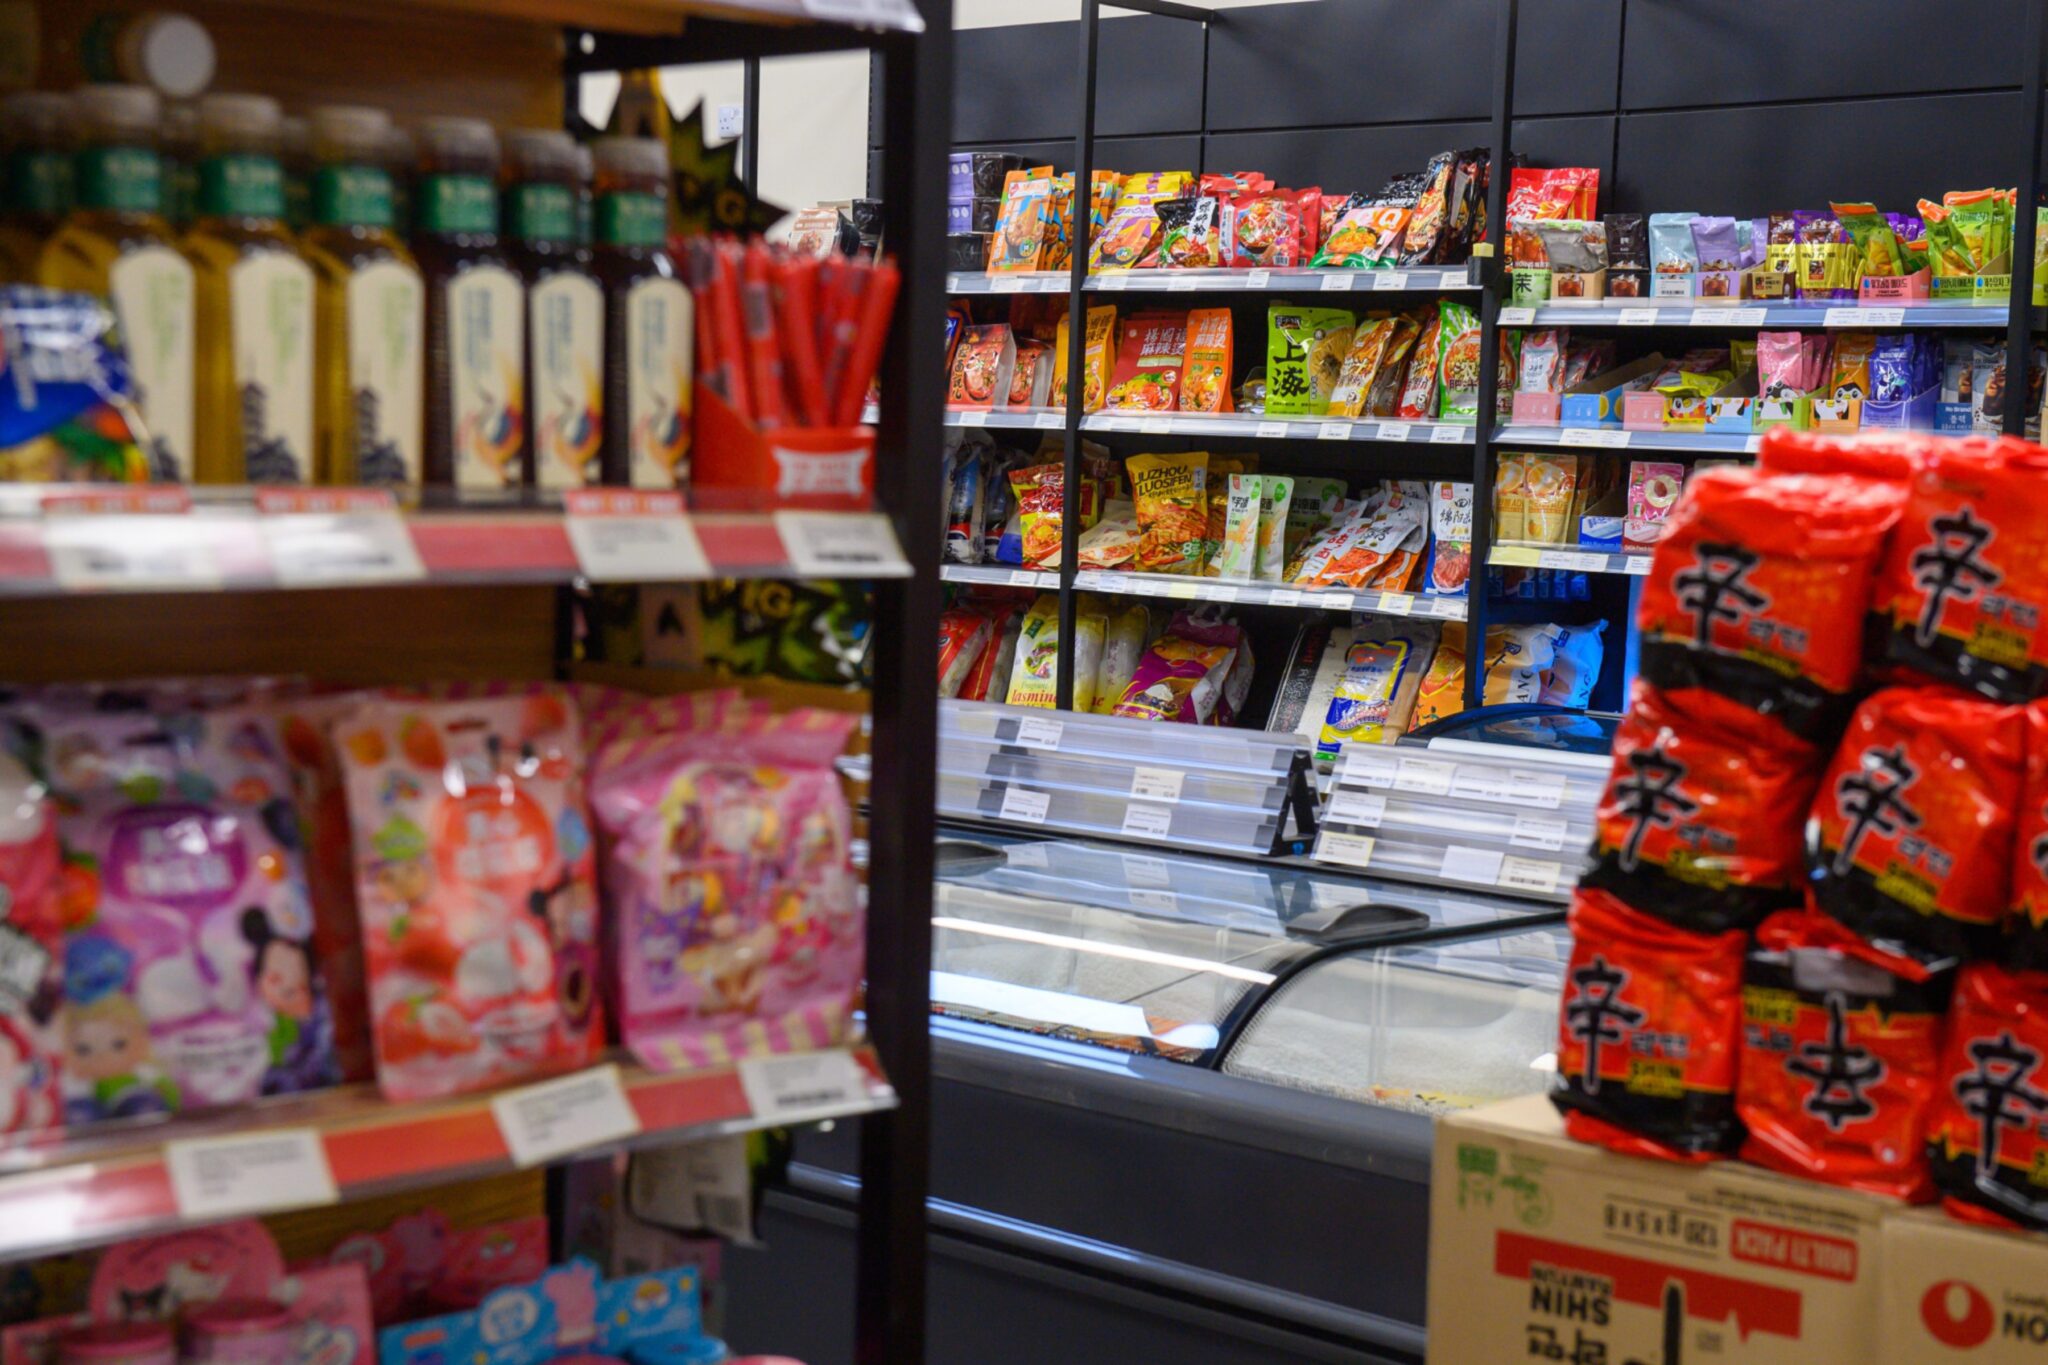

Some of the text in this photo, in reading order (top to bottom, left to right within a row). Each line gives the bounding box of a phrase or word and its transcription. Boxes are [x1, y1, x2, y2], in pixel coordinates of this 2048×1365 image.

[1515, 273, 1532, 293] 茉
[1272, 340, 1309, 397] 上海
[1138, 474, 1192, 496] LUOSIFEN
[1675, 541, 1769, 648] 辛
[1911, 506, 2001, 645] 辛
[1615, 751, 1698, 864] 辛
[1839, 747, 1922, 872] 辛
[1567, 956, 1644, 1091] 辛
[1787, 991, 1884, 1128] 辛
[1956, 1032, 2048, 1175] 辛
[1531, 1284, 1611, 1327] SHIN
